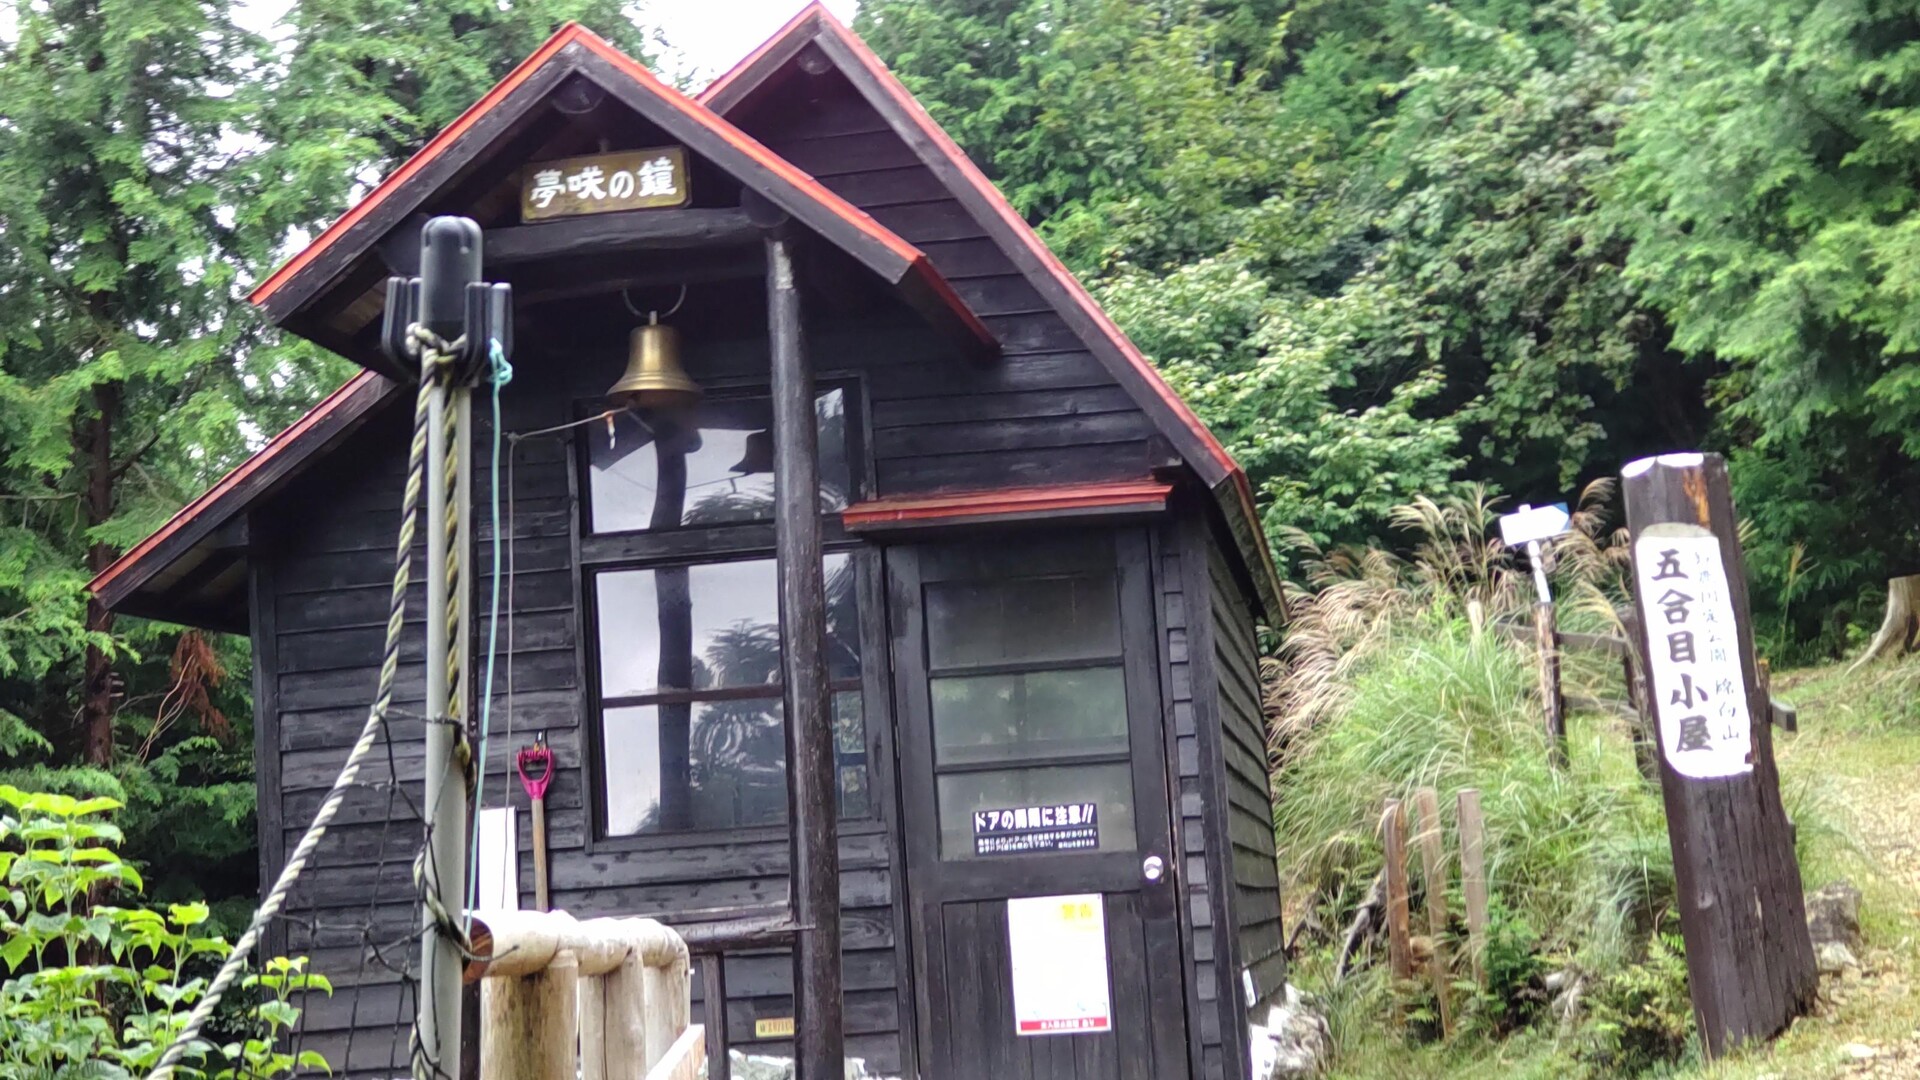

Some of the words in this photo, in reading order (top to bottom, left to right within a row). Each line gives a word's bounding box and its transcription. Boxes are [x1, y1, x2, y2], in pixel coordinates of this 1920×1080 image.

[529, 156, 678, 208] 夢咲の鐘
[1651, 548, 1713, 753] 五合目小屋
